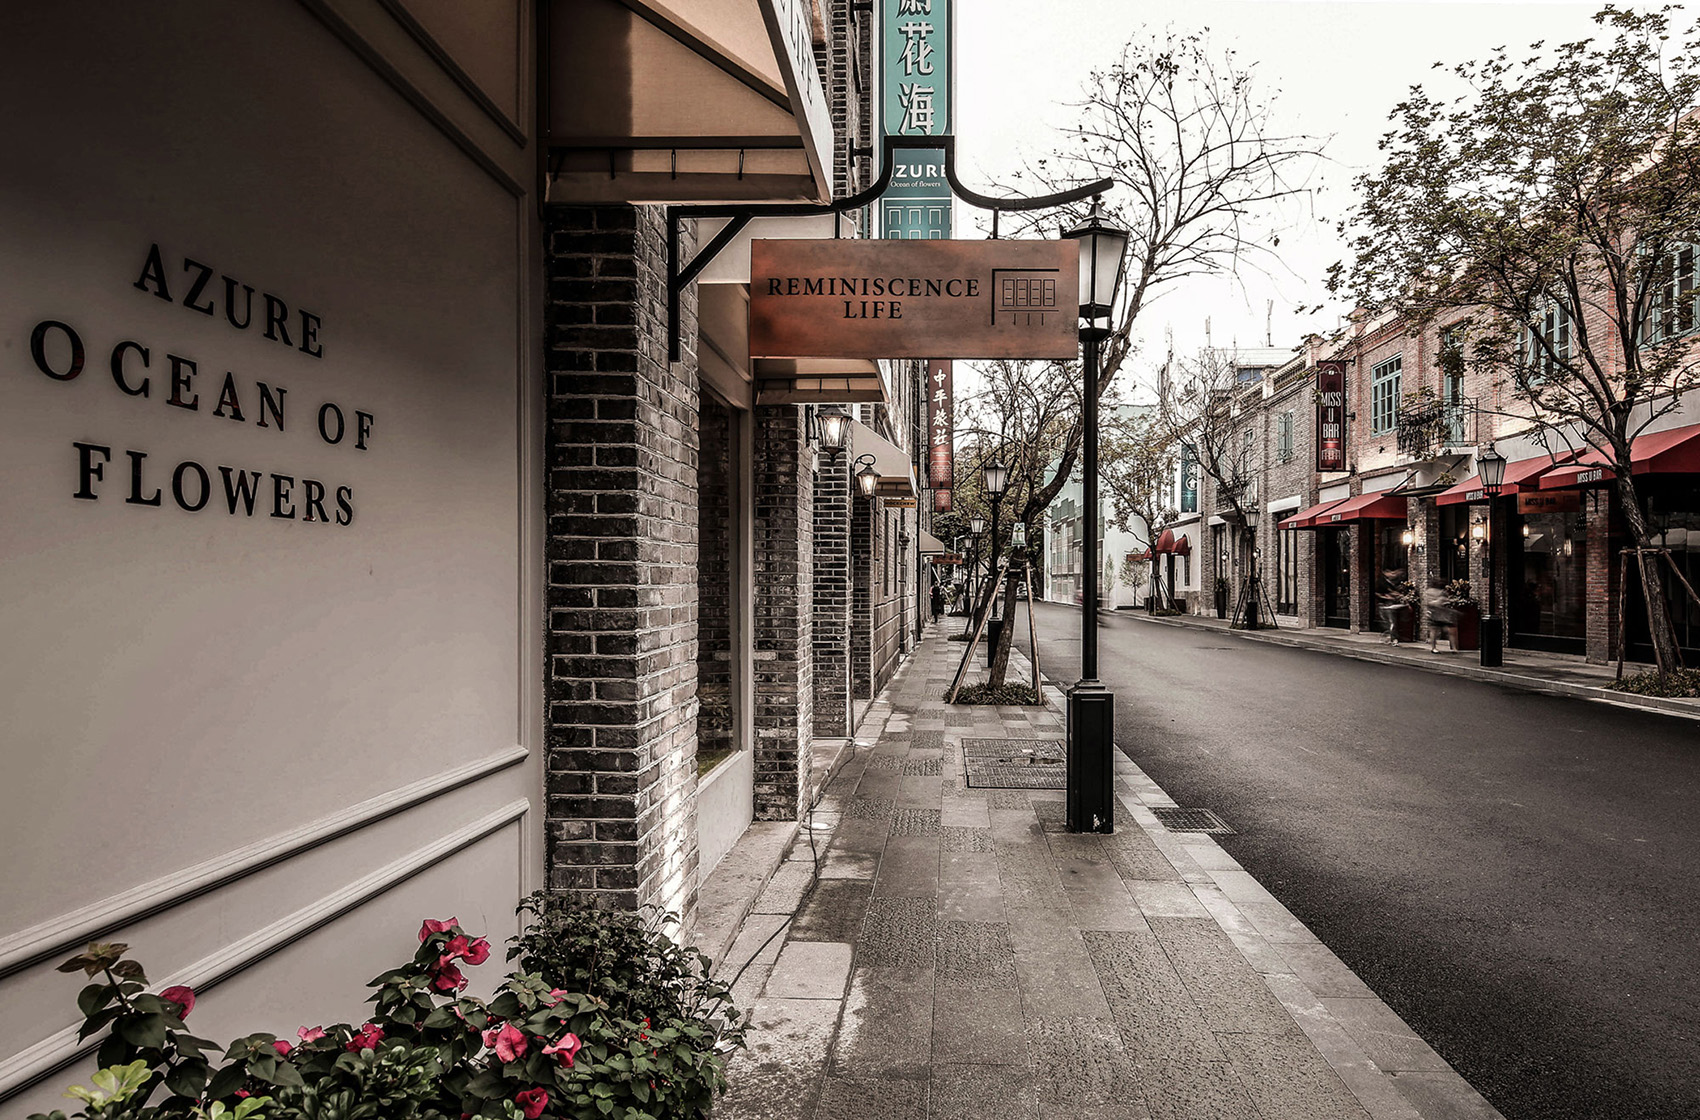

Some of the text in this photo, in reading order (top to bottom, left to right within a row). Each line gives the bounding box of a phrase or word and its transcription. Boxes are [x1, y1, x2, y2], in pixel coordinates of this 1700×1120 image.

[892, 164, 946, 178] ZURE
[767, 277, 980, 297] REMINISCENCE
[133, 243, 323, 358] AZURE
[843, 301, 903, 319] LIFE
[30, 320, 374, 450] OCEAN OF
[932, 368, 949, 445] 中平旅社
[1321, 391, 1341, 407] MISS
[1328, 407, 1334, 422] U
[1323, 423, 1339, 439] BAR
[73, 442, 353, 527] FLOWERS
[1577, 469, 1603, 483] MISS U BAR
